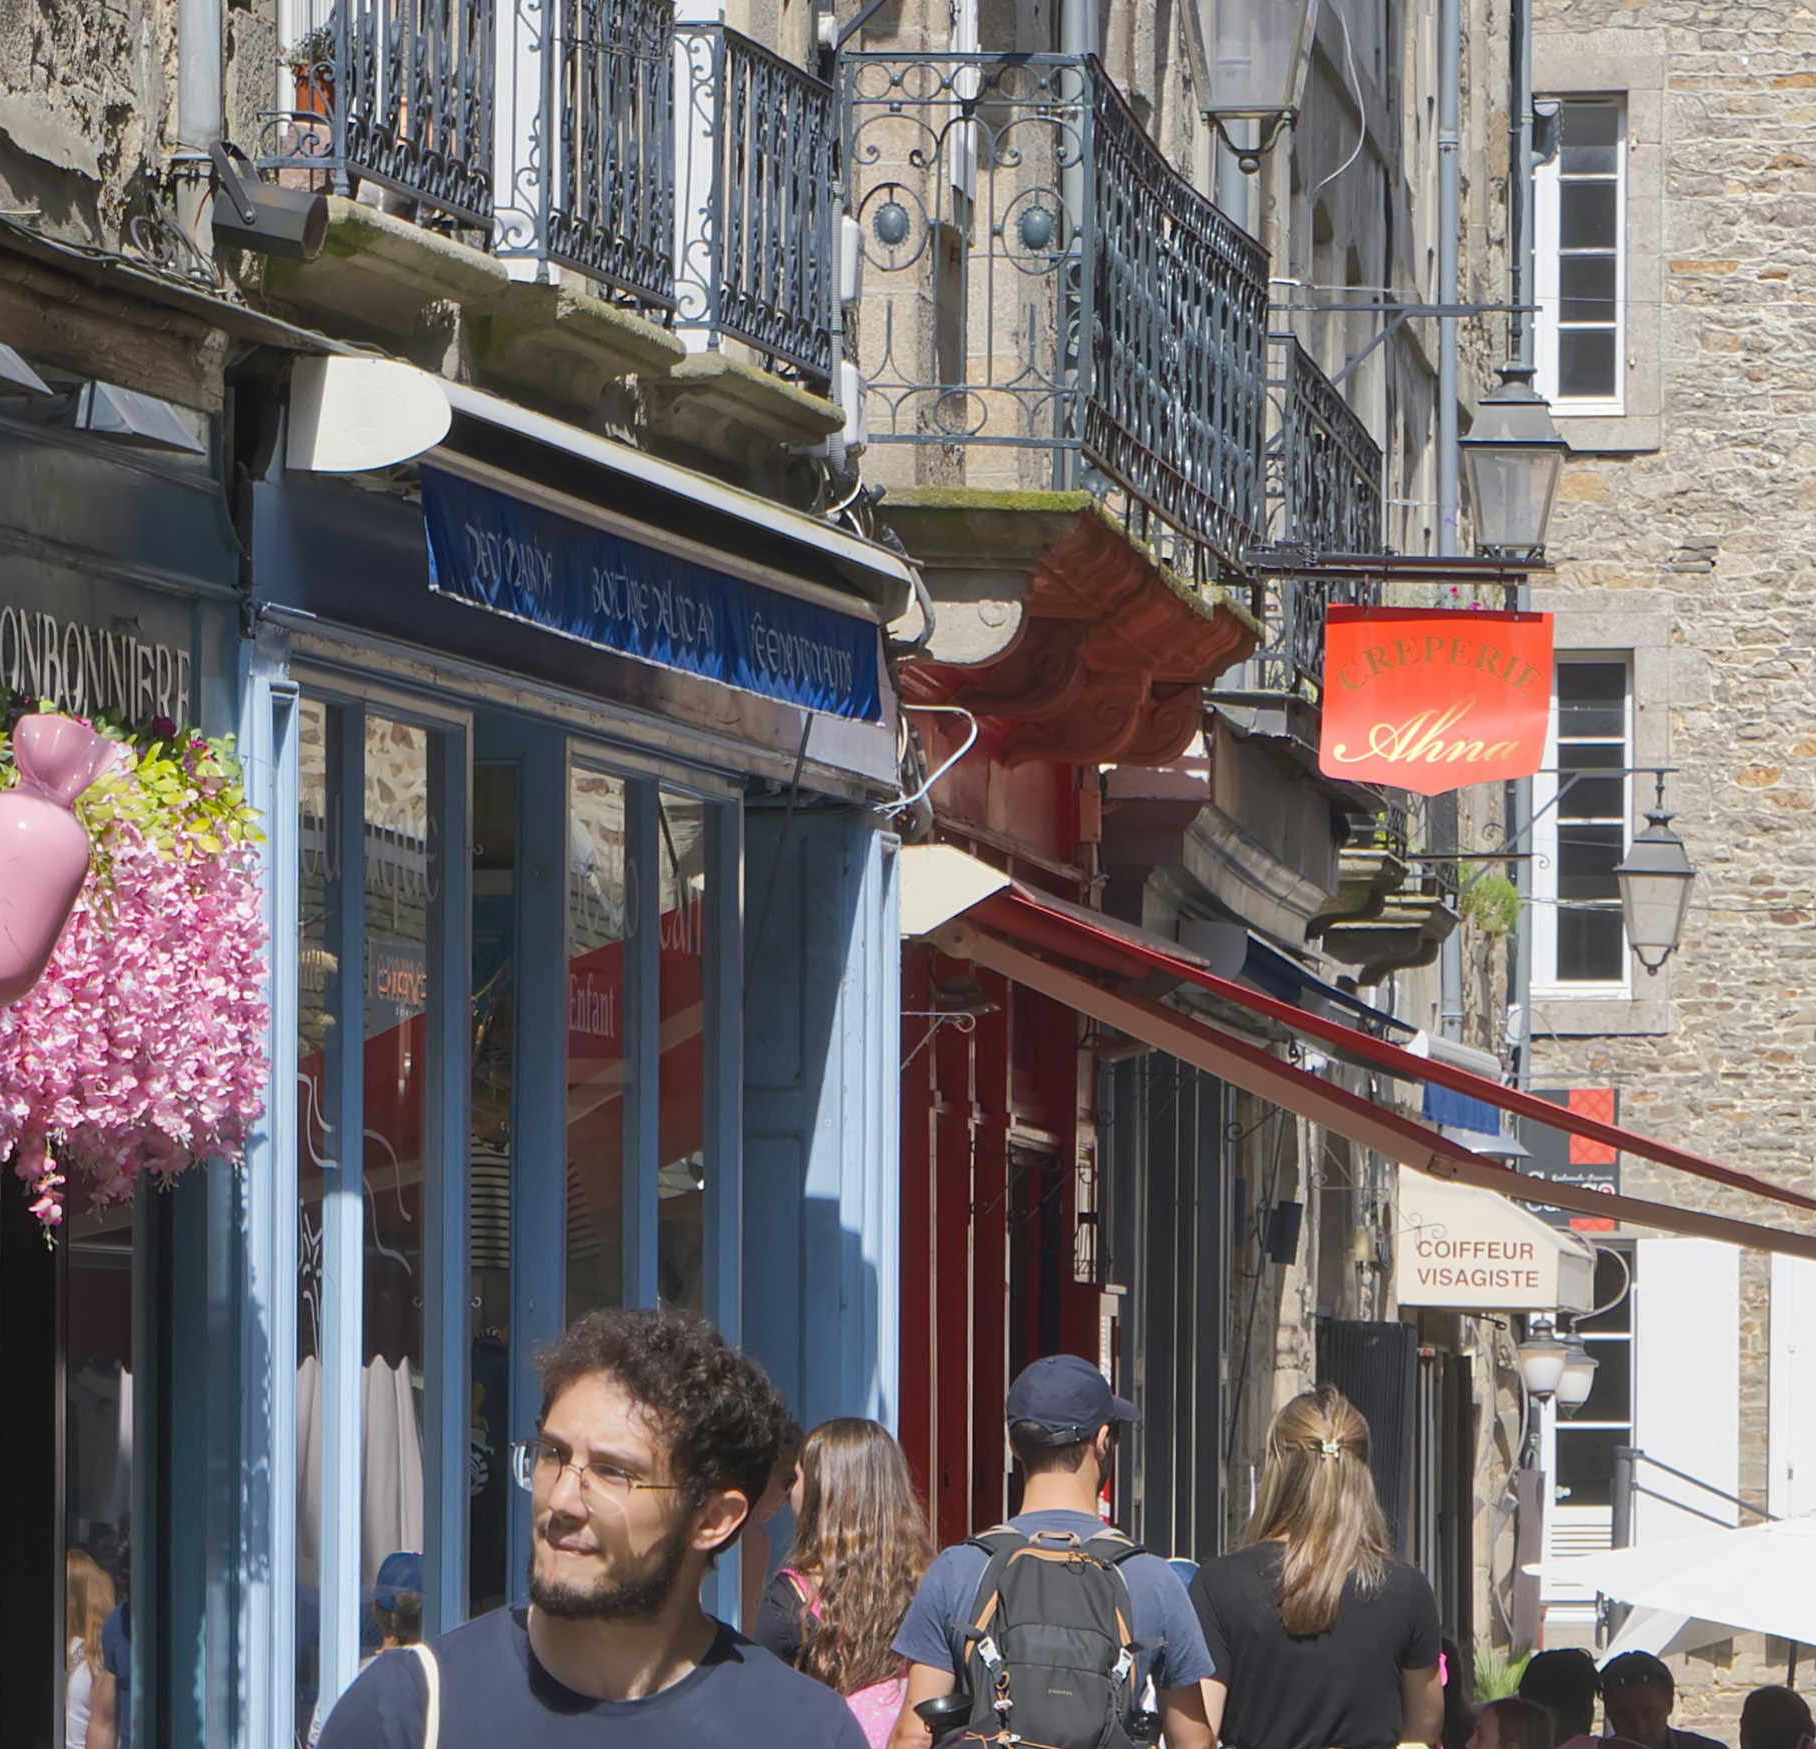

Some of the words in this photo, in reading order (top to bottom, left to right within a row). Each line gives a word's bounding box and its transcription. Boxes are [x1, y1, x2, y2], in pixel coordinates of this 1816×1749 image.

[1338, 635, 1546, 698] CREPERIE
[567, 972, 615, 1039] Enfant
[1418, 1241, 1534, 1260] COIFFEUR
[1417, 1268, 1540, 1289] VISAGISTE
